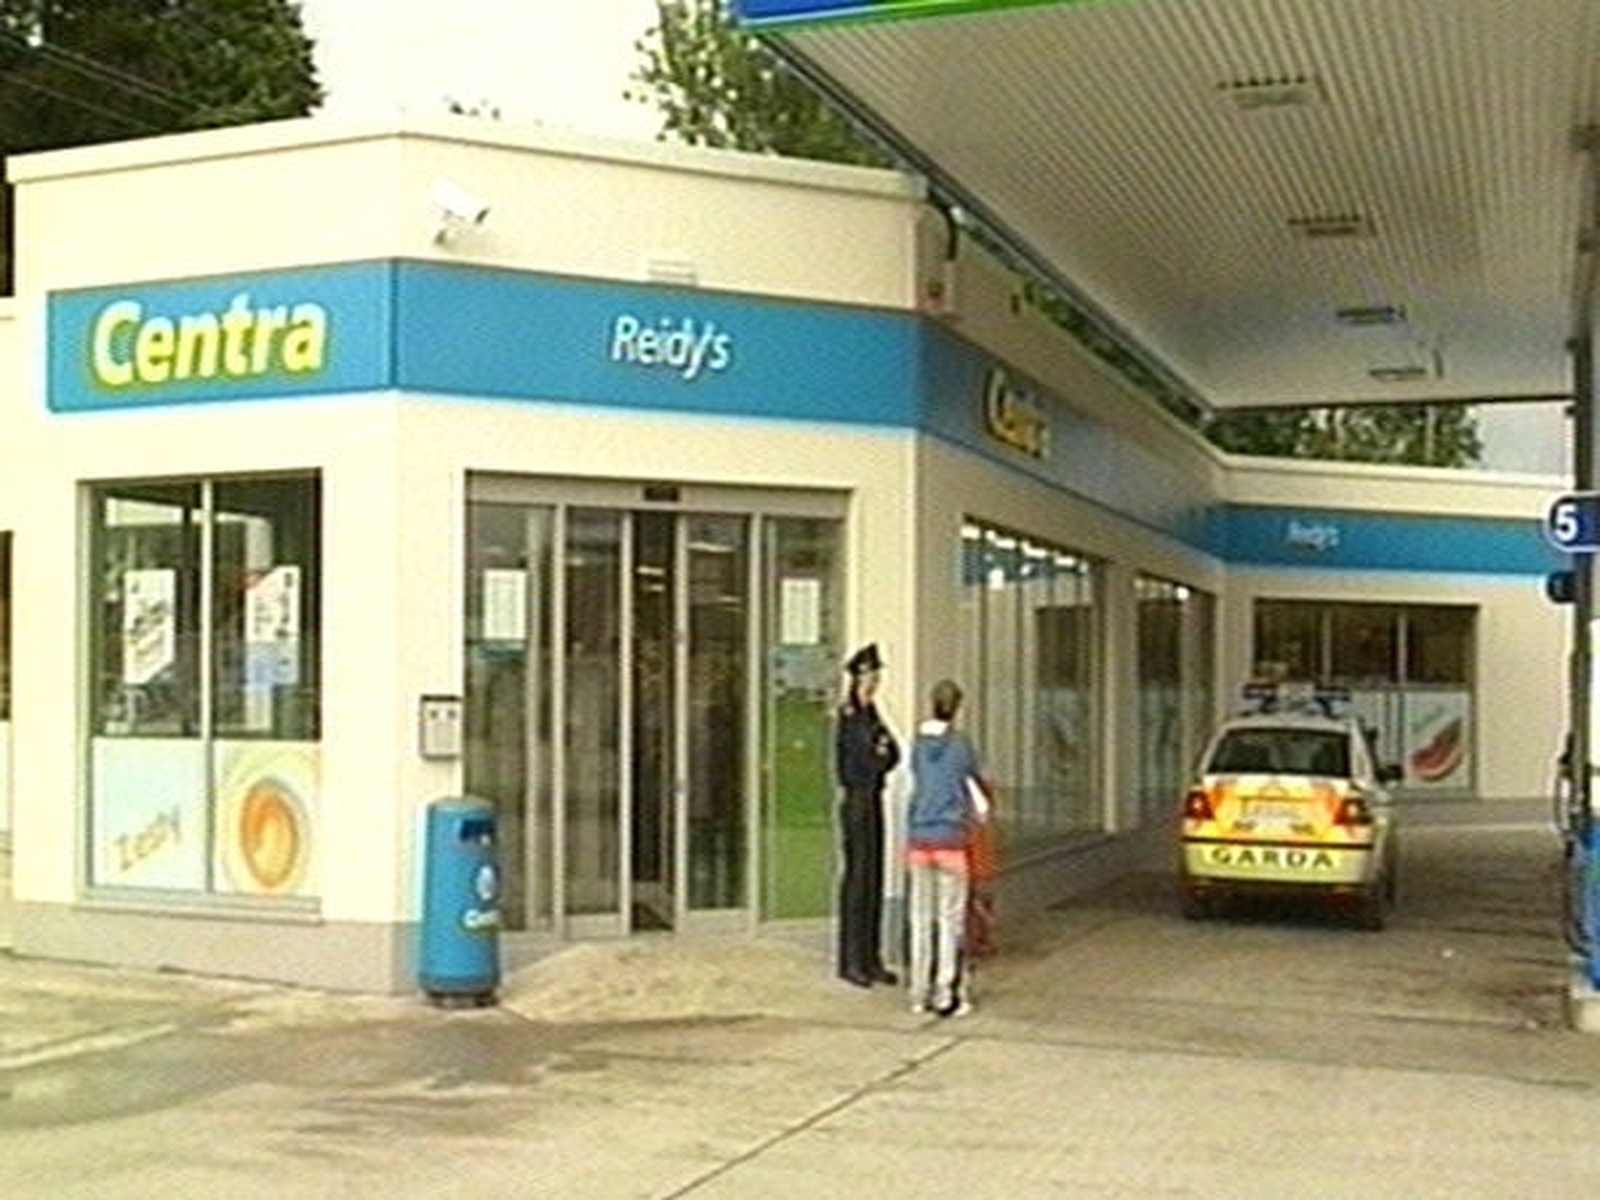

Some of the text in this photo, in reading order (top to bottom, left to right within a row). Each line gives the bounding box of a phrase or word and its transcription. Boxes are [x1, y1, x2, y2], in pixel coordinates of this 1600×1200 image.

[92, 293, 327, 386] Centra
[611, 315, 731, 380] Reidy's
[1555, 503, 1579, 542] 5
[1211, 848, 1333, 868] GARDA
